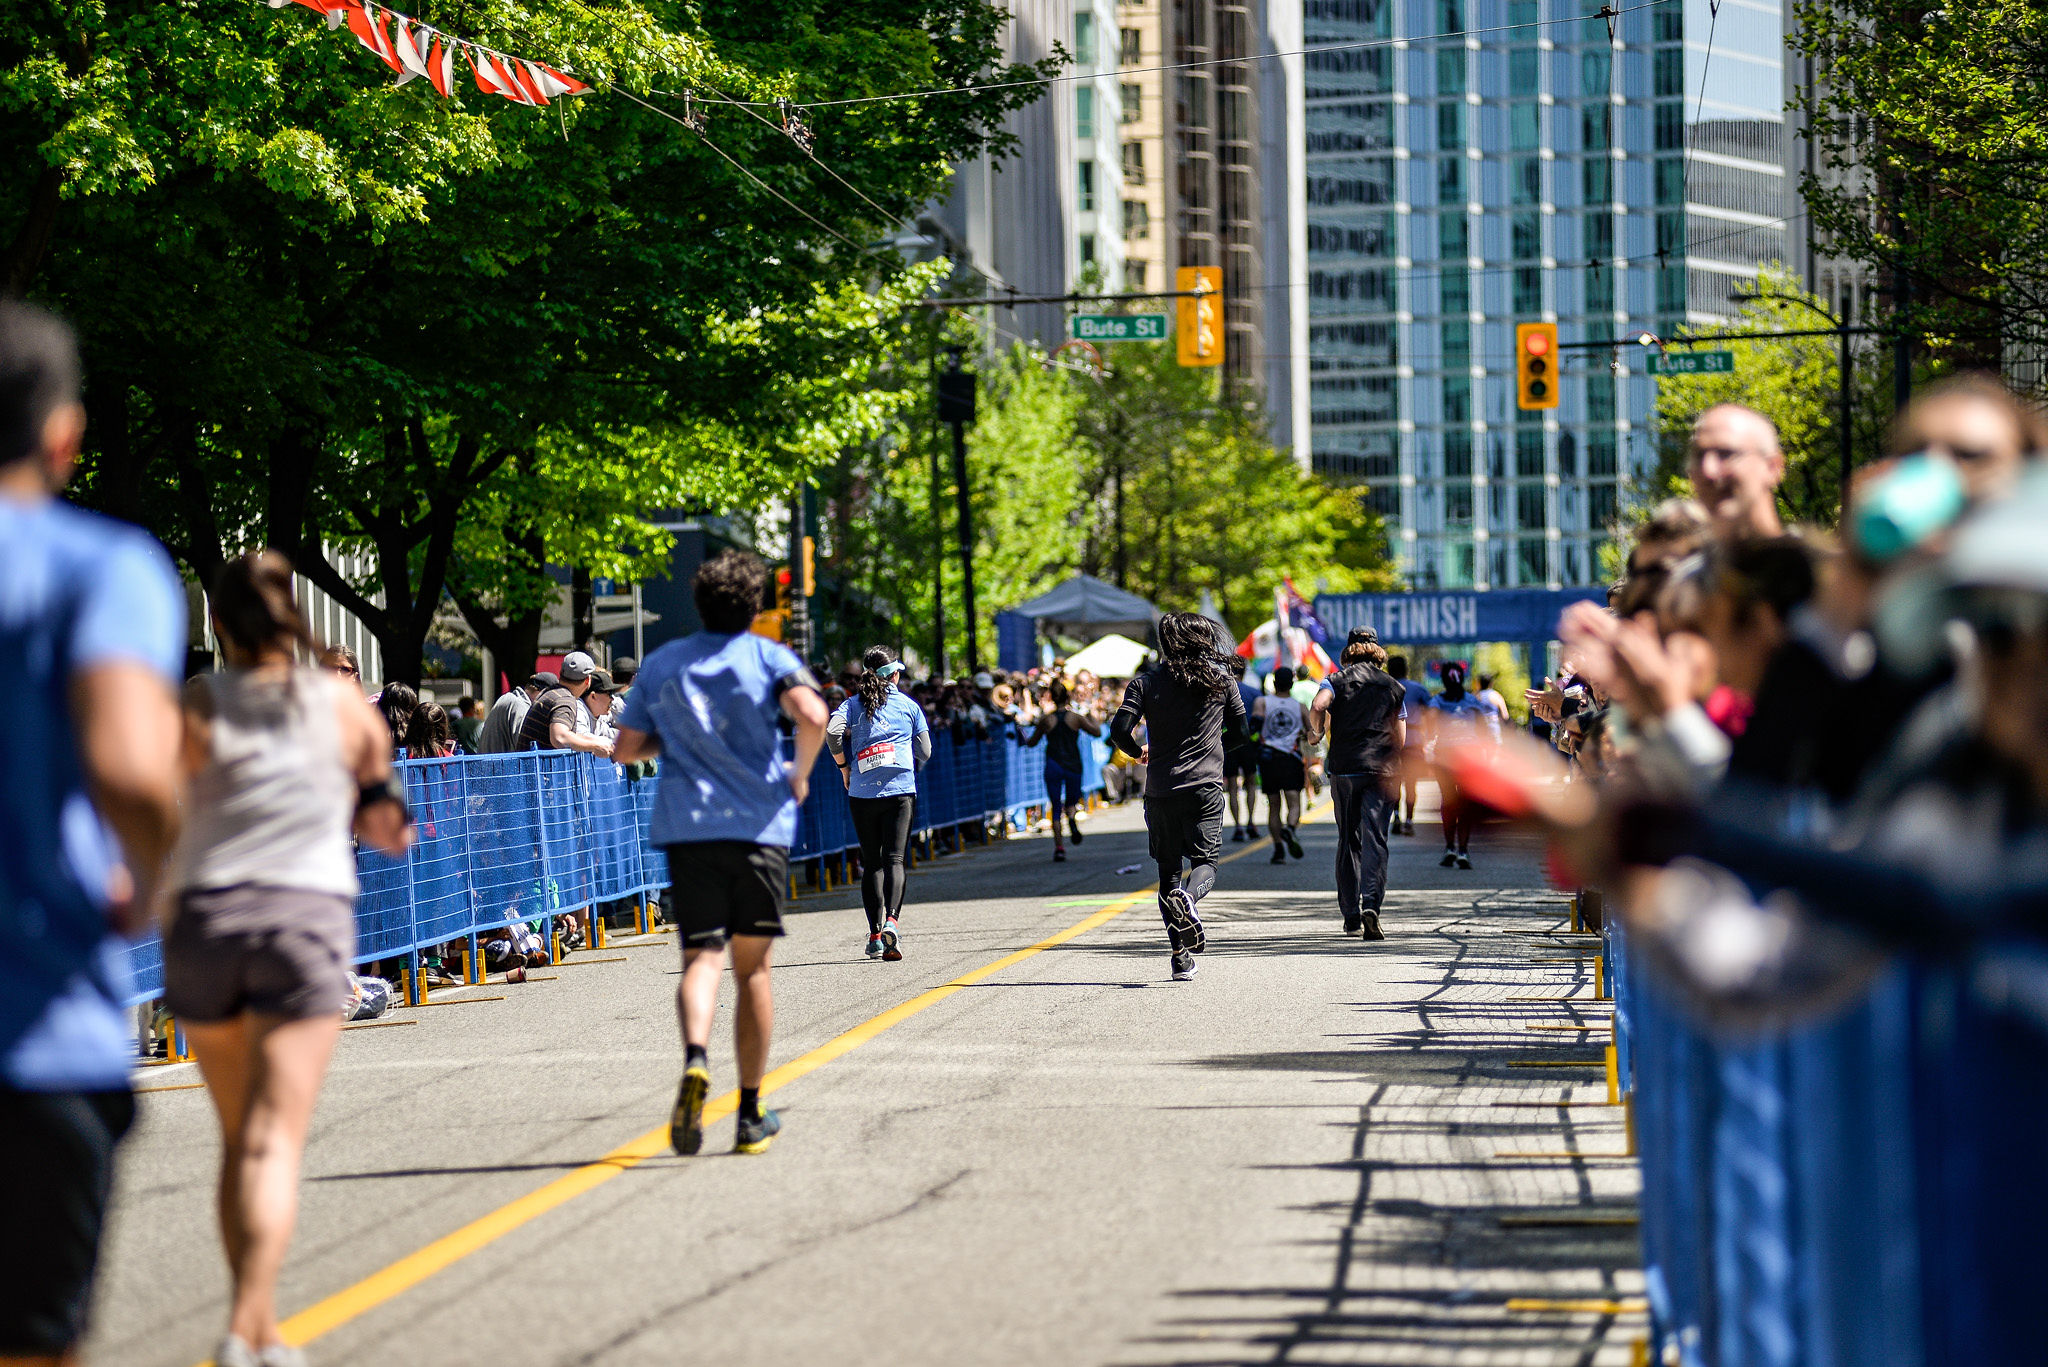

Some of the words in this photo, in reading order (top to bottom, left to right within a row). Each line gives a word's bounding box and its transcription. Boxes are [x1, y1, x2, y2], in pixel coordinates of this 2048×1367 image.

[1080, 319, 1127, 336] Bute
[1135, 318, 1157, 336] St
[1705, 355, 1723, 369] St
[1316, 600, 1374, 641] RUN
[1383, 597, 1477, 638] FINISH
